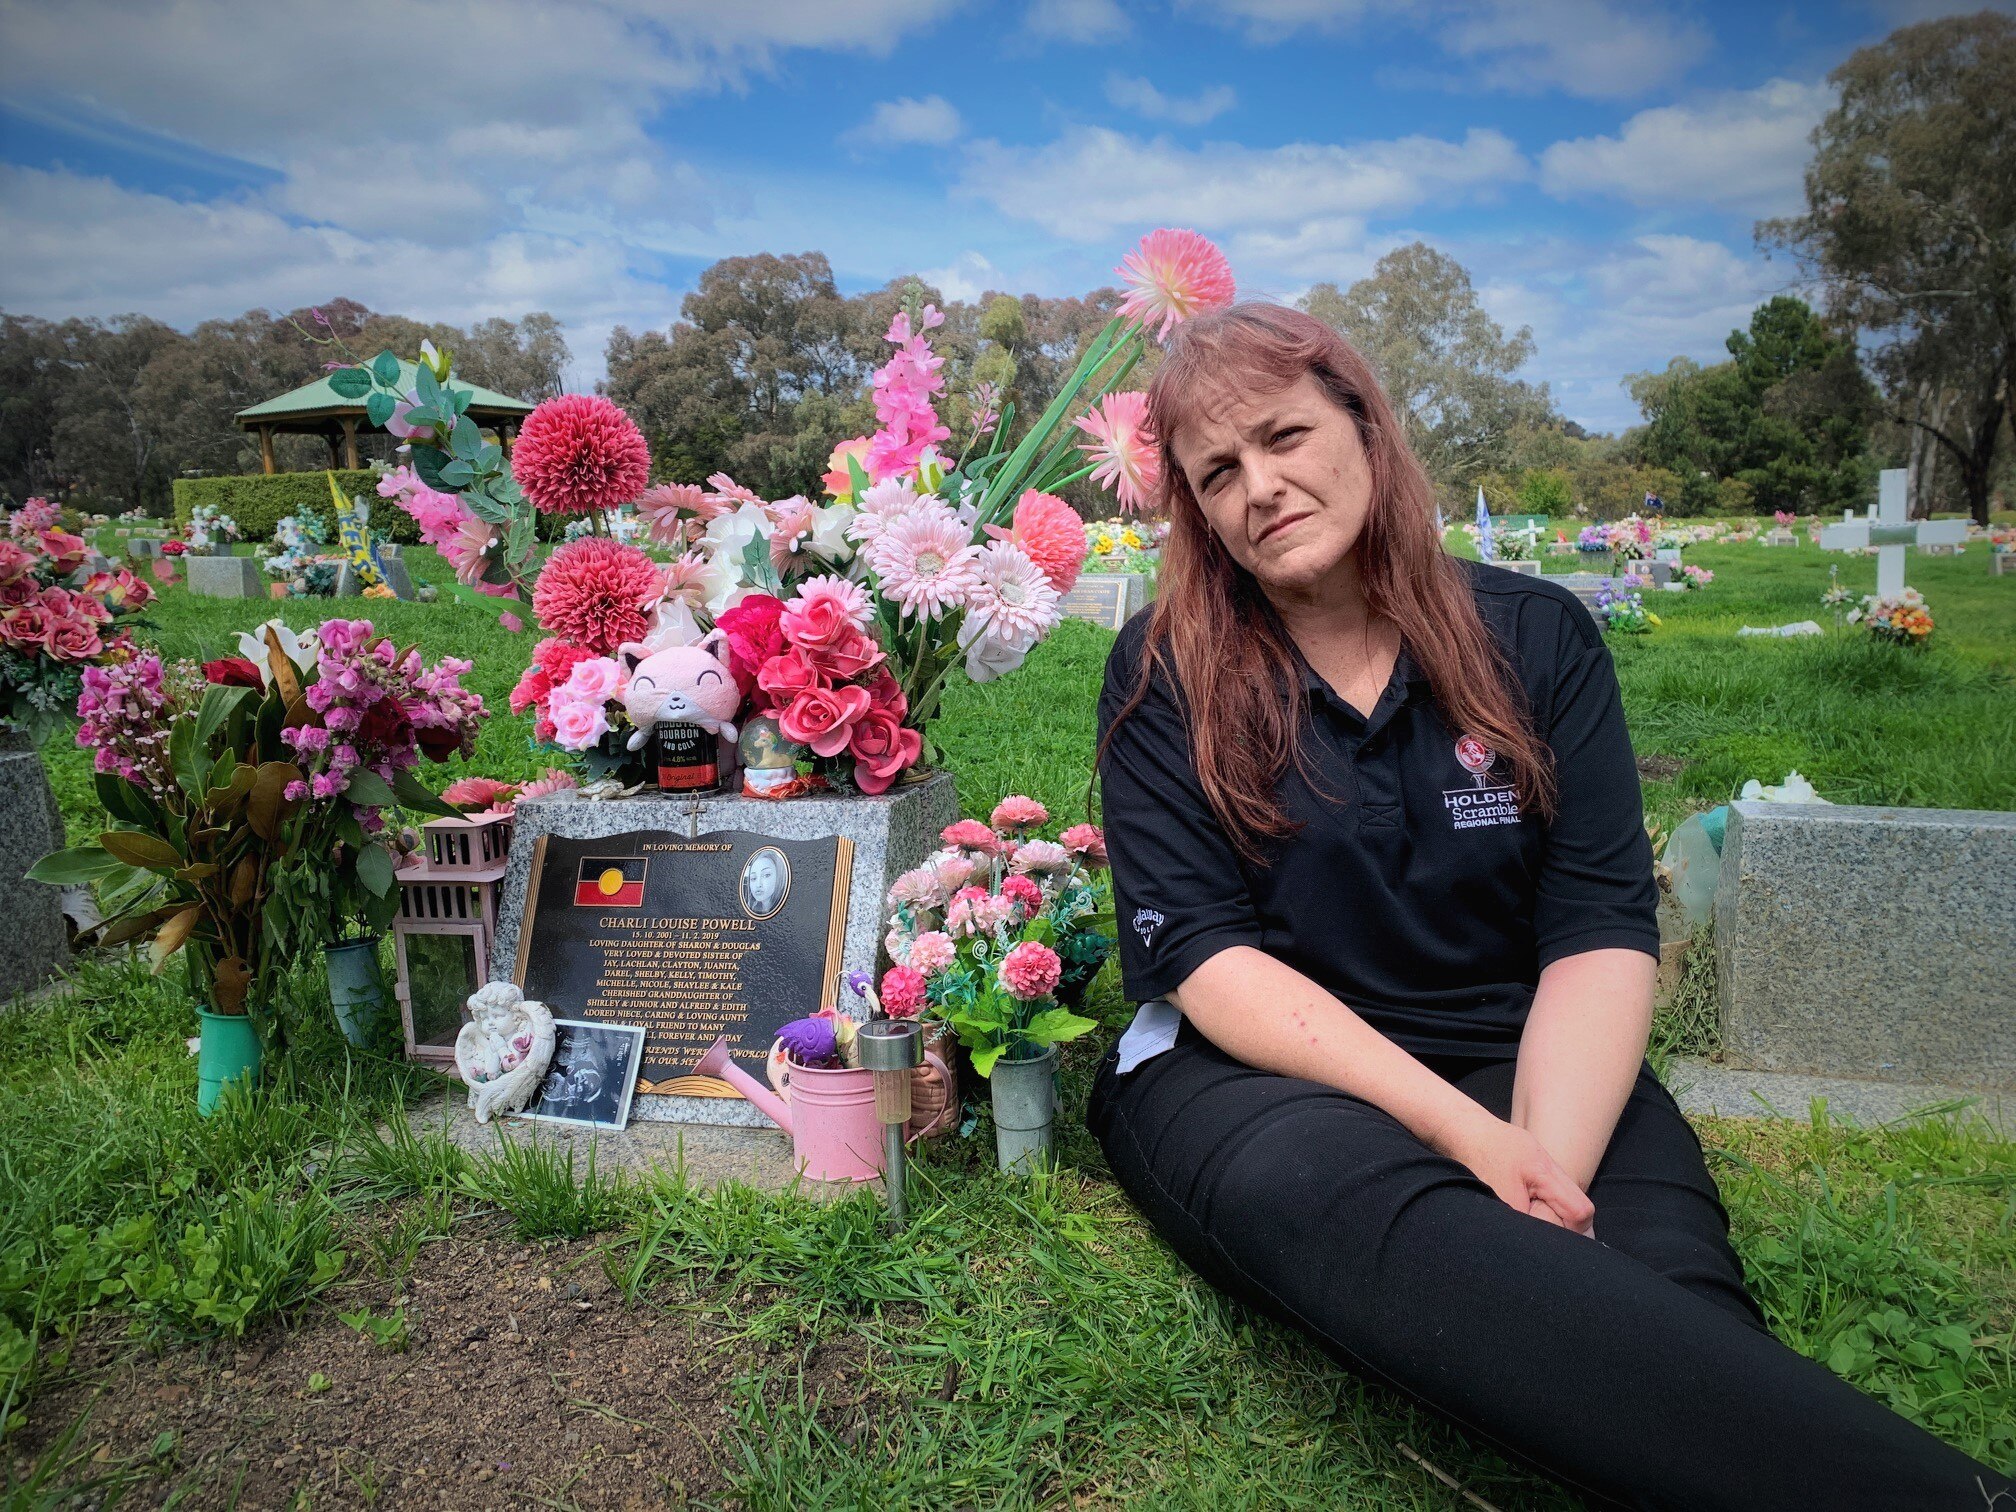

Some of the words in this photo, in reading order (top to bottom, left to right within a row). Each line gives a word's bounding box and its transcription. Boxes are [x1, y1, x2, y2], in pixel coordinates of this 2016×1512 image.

[659, 729, 699, 739] BOURBON
[663, 741, 675, 750] AND
[678, 740, 695, 751] COLA
[1444, 790, 1521, 809] HOLDEN
[1452, 803, 1518, 820] Scramble
[1454, 819, 1499, 829] REGIONAL
[1500, 816, 1521, 824] FINAL
[600, 918, 647, 929] CHARLI
[652, 918, 698, 930] LOUISE
[702, 919, 756, 931] POWELL
[621, 940, 664, 948] DAUGHTER
[722, 942, 761, 950] DOUGLAS
[663, 951, 700, 959] DEVOTED
[603, 960, 618, 968] JAY,
[621, 960, 660, 969] LACHLAN,
[662, 961, 701, 969] CLAYTON,
[703, 962, 740, 970] JUANITA,
[604, 970, 633, 978] DAREL,
[635, 971, 667, 979] SHELBY,
[698, 972, 736, 981] TIMOTHY,
[596, 980, 638, 988] MICHELLE,
[640, 981, 671, 989] NICOLE,
[674, 982, 709, 990] SHAYLEE
[602, 990, 646, 998] CHERISHED
[648, 991, 720, 1000] GRANDDAUGHTER
[679, 1002, 710, 1010] ALFRED
[722, 1003, 747, 1011] EDITH
[583, 1009, 615, 1017] ADORED
[618, 1010, 643, 1019] NIECE,
[645, 1011, 675, 1019] CARING
[677, 1012, 684, 1020] &
[686, 1013, 717, 1021] LOVING
[719, 1014, 749, 1022] AUNTY
[656, 1022, 685, 1030] FRIEND
[688, 1022, 698, 1030] TO
[700, 1023, 725, 1031] MANY
[658, 1033, 695, 1041] FOREVER
[659, 1057, 678, 1065] OUR
